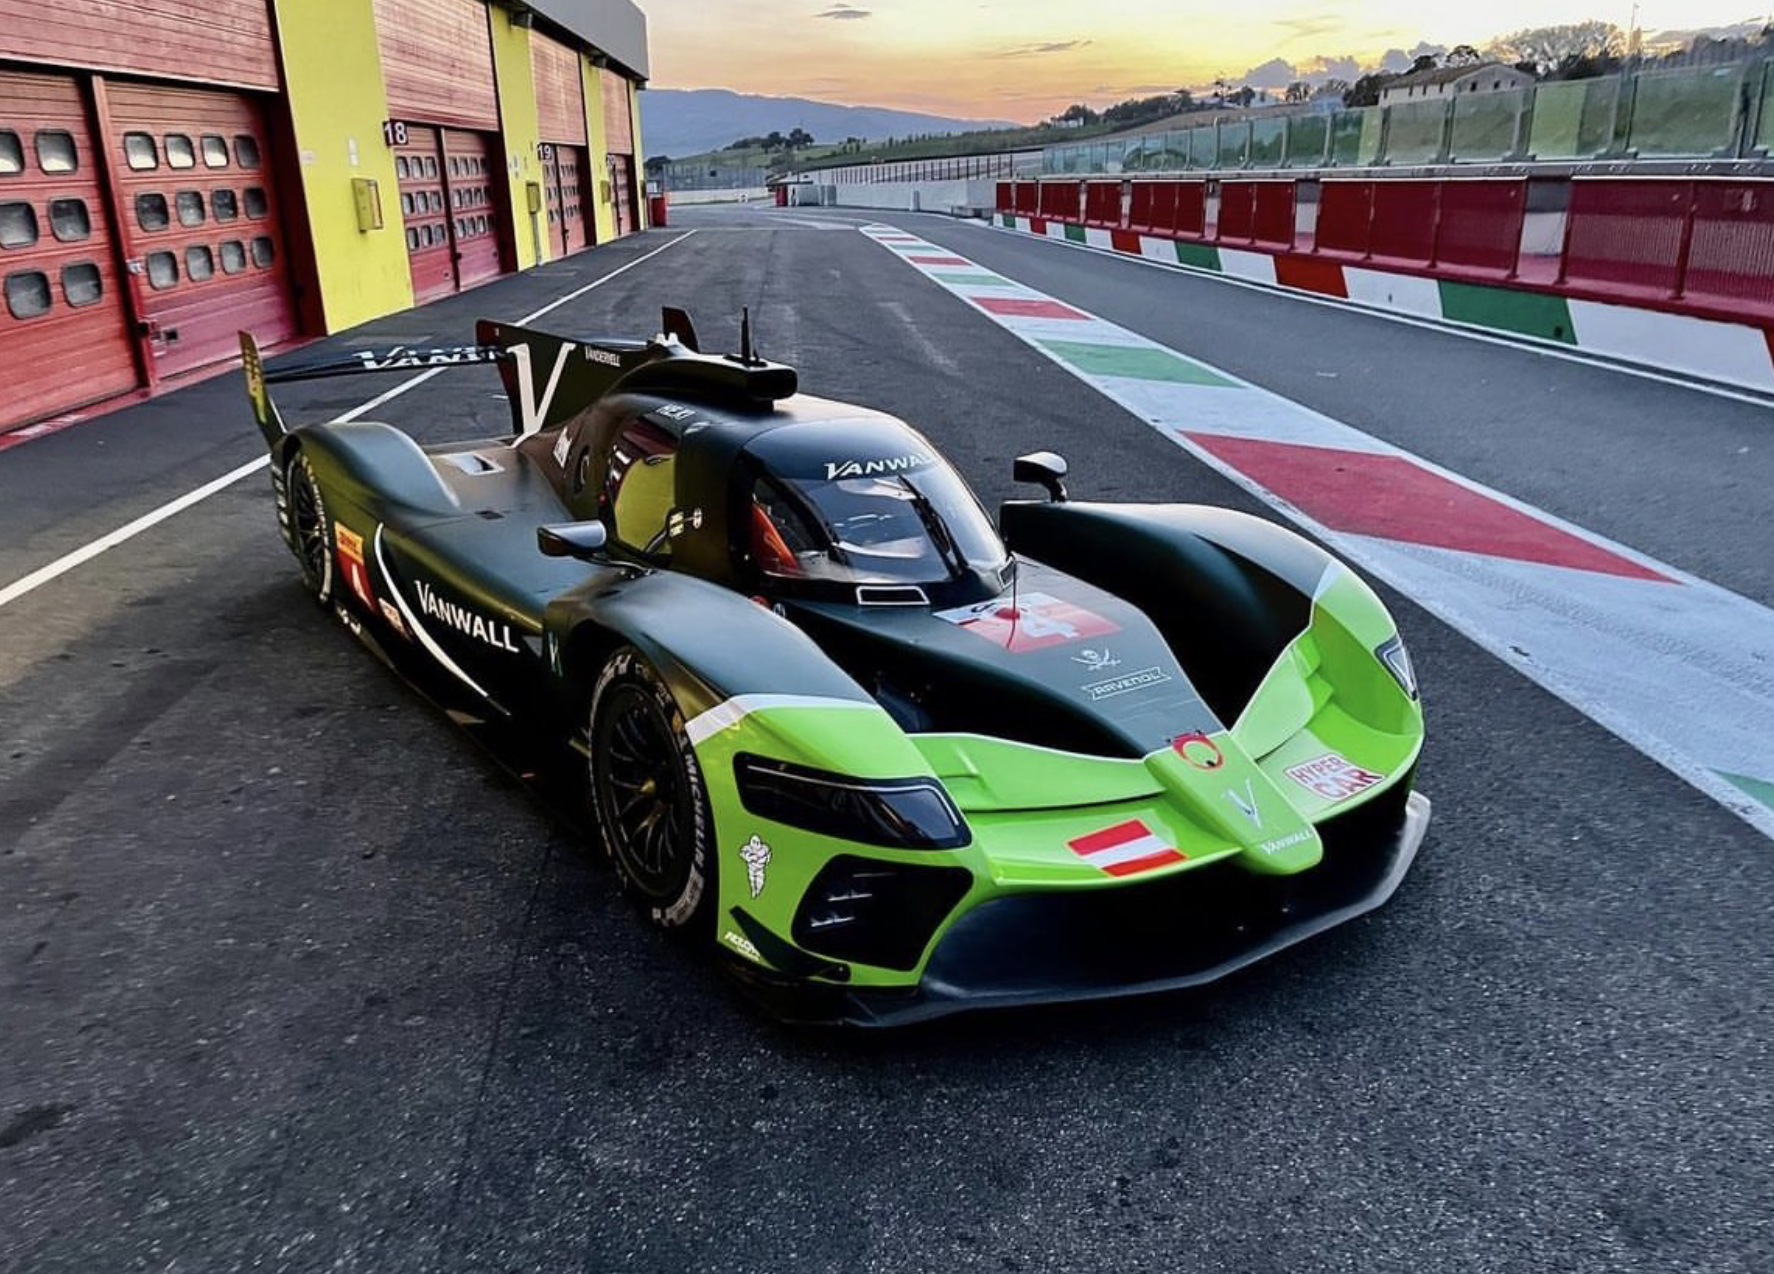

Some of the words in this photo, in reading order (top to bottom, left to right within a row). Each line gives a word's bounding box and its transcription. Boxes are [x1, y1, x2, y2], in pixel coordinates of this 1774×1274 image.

[385, 121, 407, 145] 18
[537, 144, 551, 160] 19
[506, 342, 577, 449] V
[413, 579, 521, 654] VANWALL
[1092, 666, 1163, 695] RAVENOL
[1289, 756, 1346, 785] HYPER
[1313, 768, 1384, 798] CAR
[684, 753, 706, 868] MICHELIN
[1260, 829, 1317, 856] VANWALL
